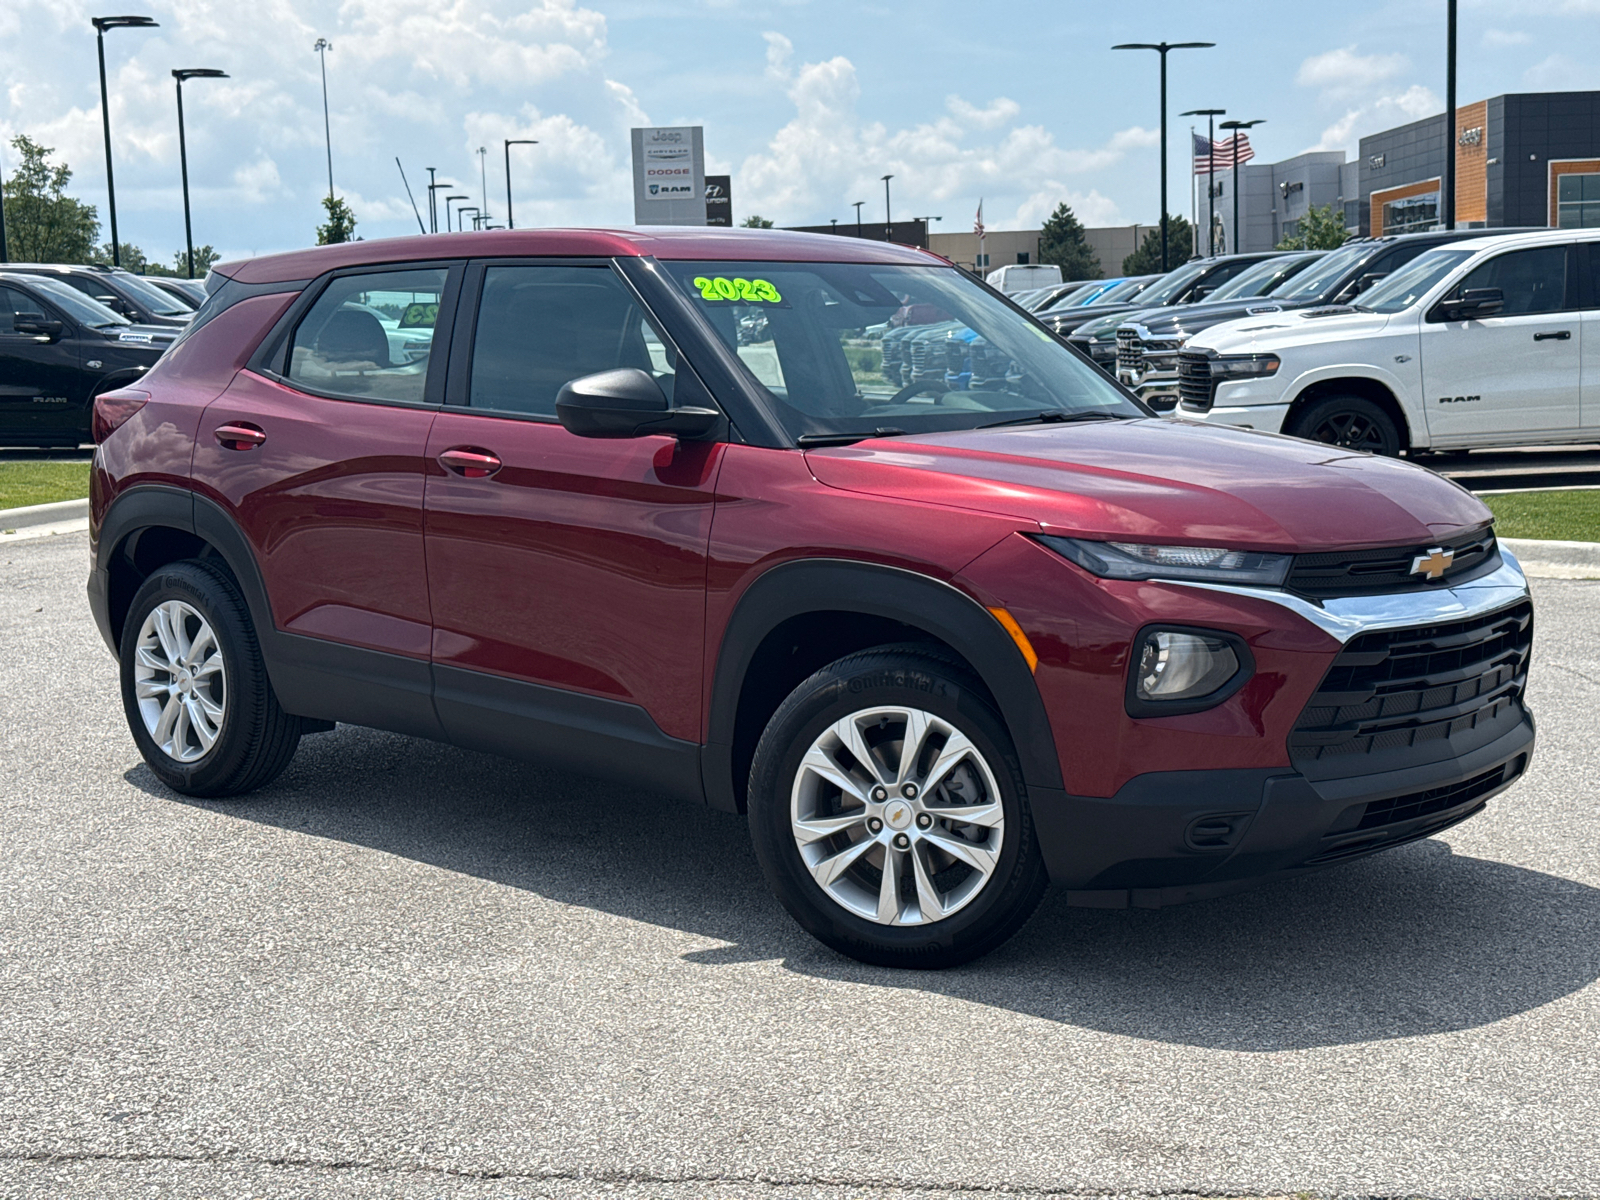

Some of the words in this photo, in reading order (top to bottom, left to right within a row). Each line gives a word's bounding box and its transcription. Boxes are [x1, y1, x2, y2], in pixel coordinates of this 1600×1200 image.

[652, 130, 682, 143] Jeep
[694, 277, 781, 303] 2023
[1439, 395, 1480, 403] RAM
